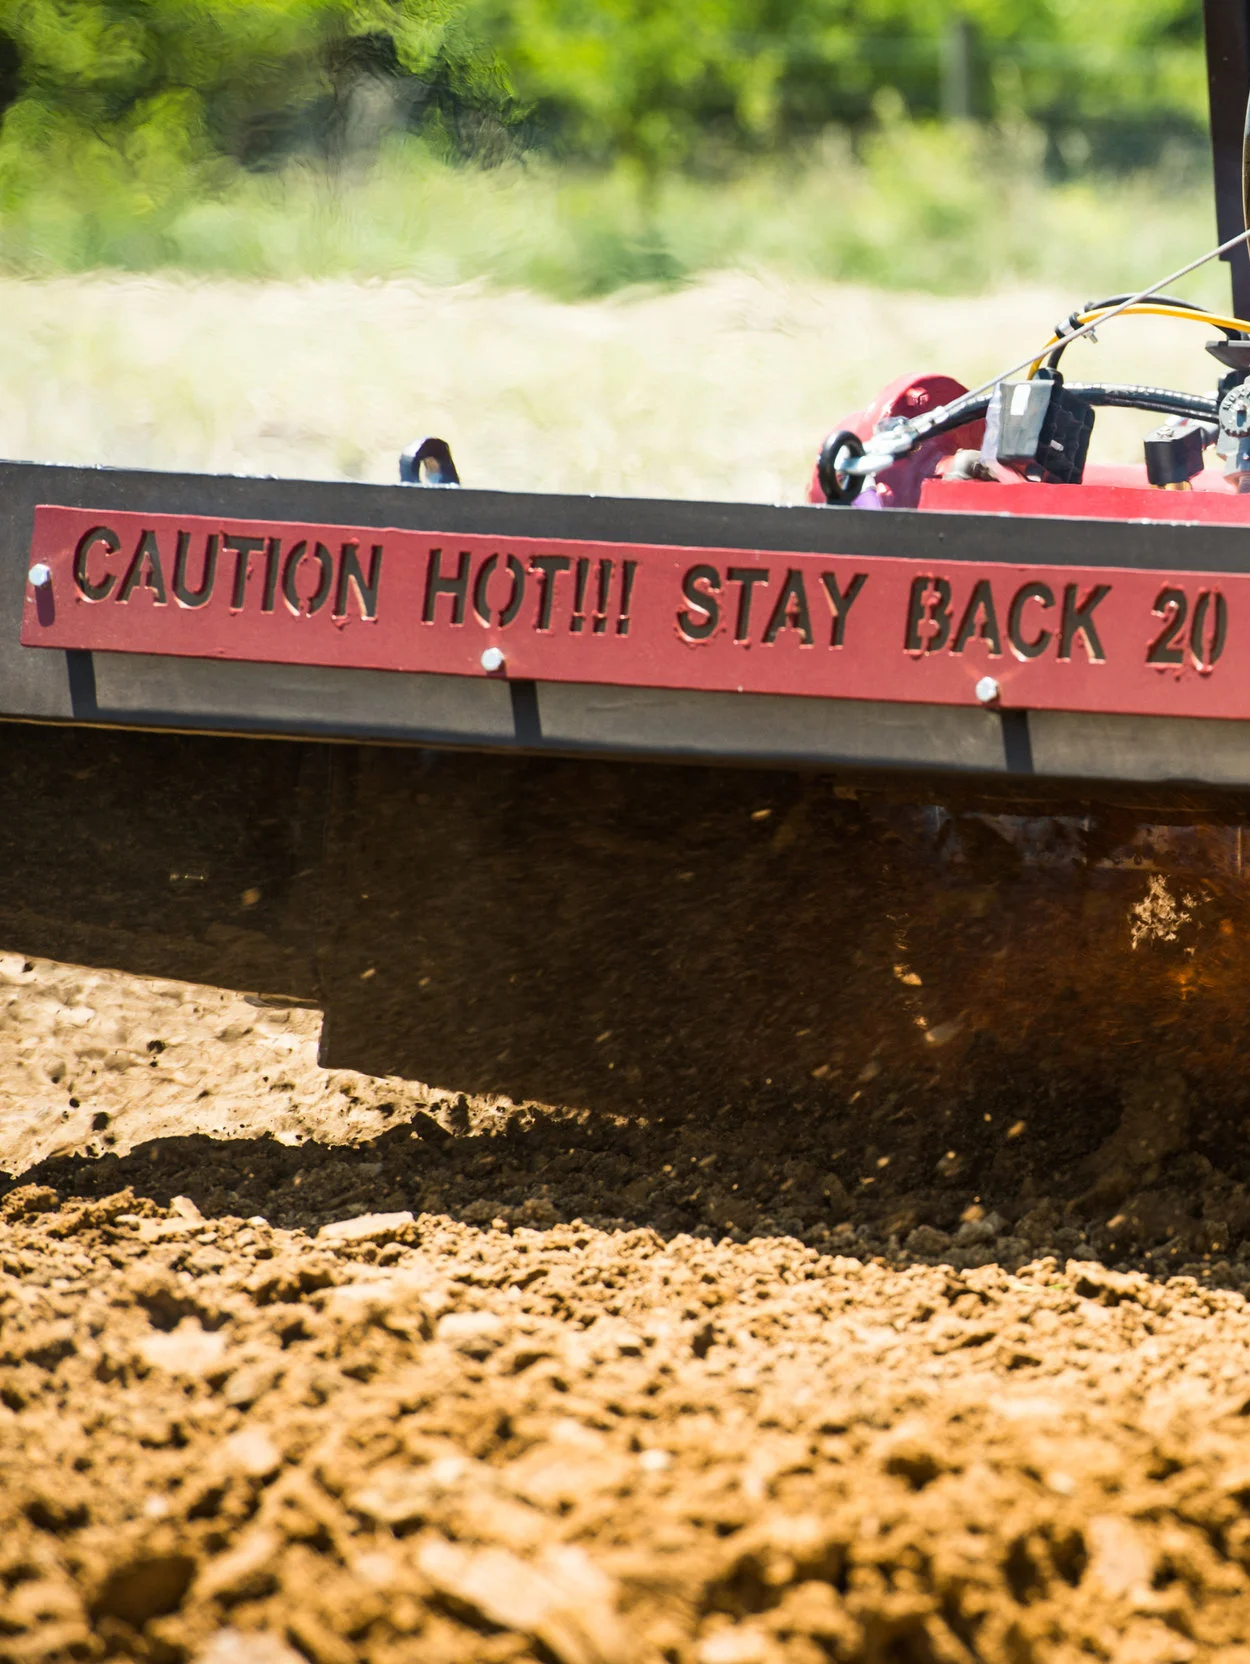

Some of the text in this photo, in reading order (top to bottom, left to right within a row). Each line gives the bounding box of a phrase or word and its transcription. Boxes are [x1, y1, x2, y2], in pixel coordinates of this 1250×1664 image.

[74, 526, 383, 622] CAUTION
[422, 548, 639, 637] HOT!!!
[674, 564, 868, 650] STAY
[903, 574, 1112, 663] BACK
[1144, 586, 1228, 674] 20
